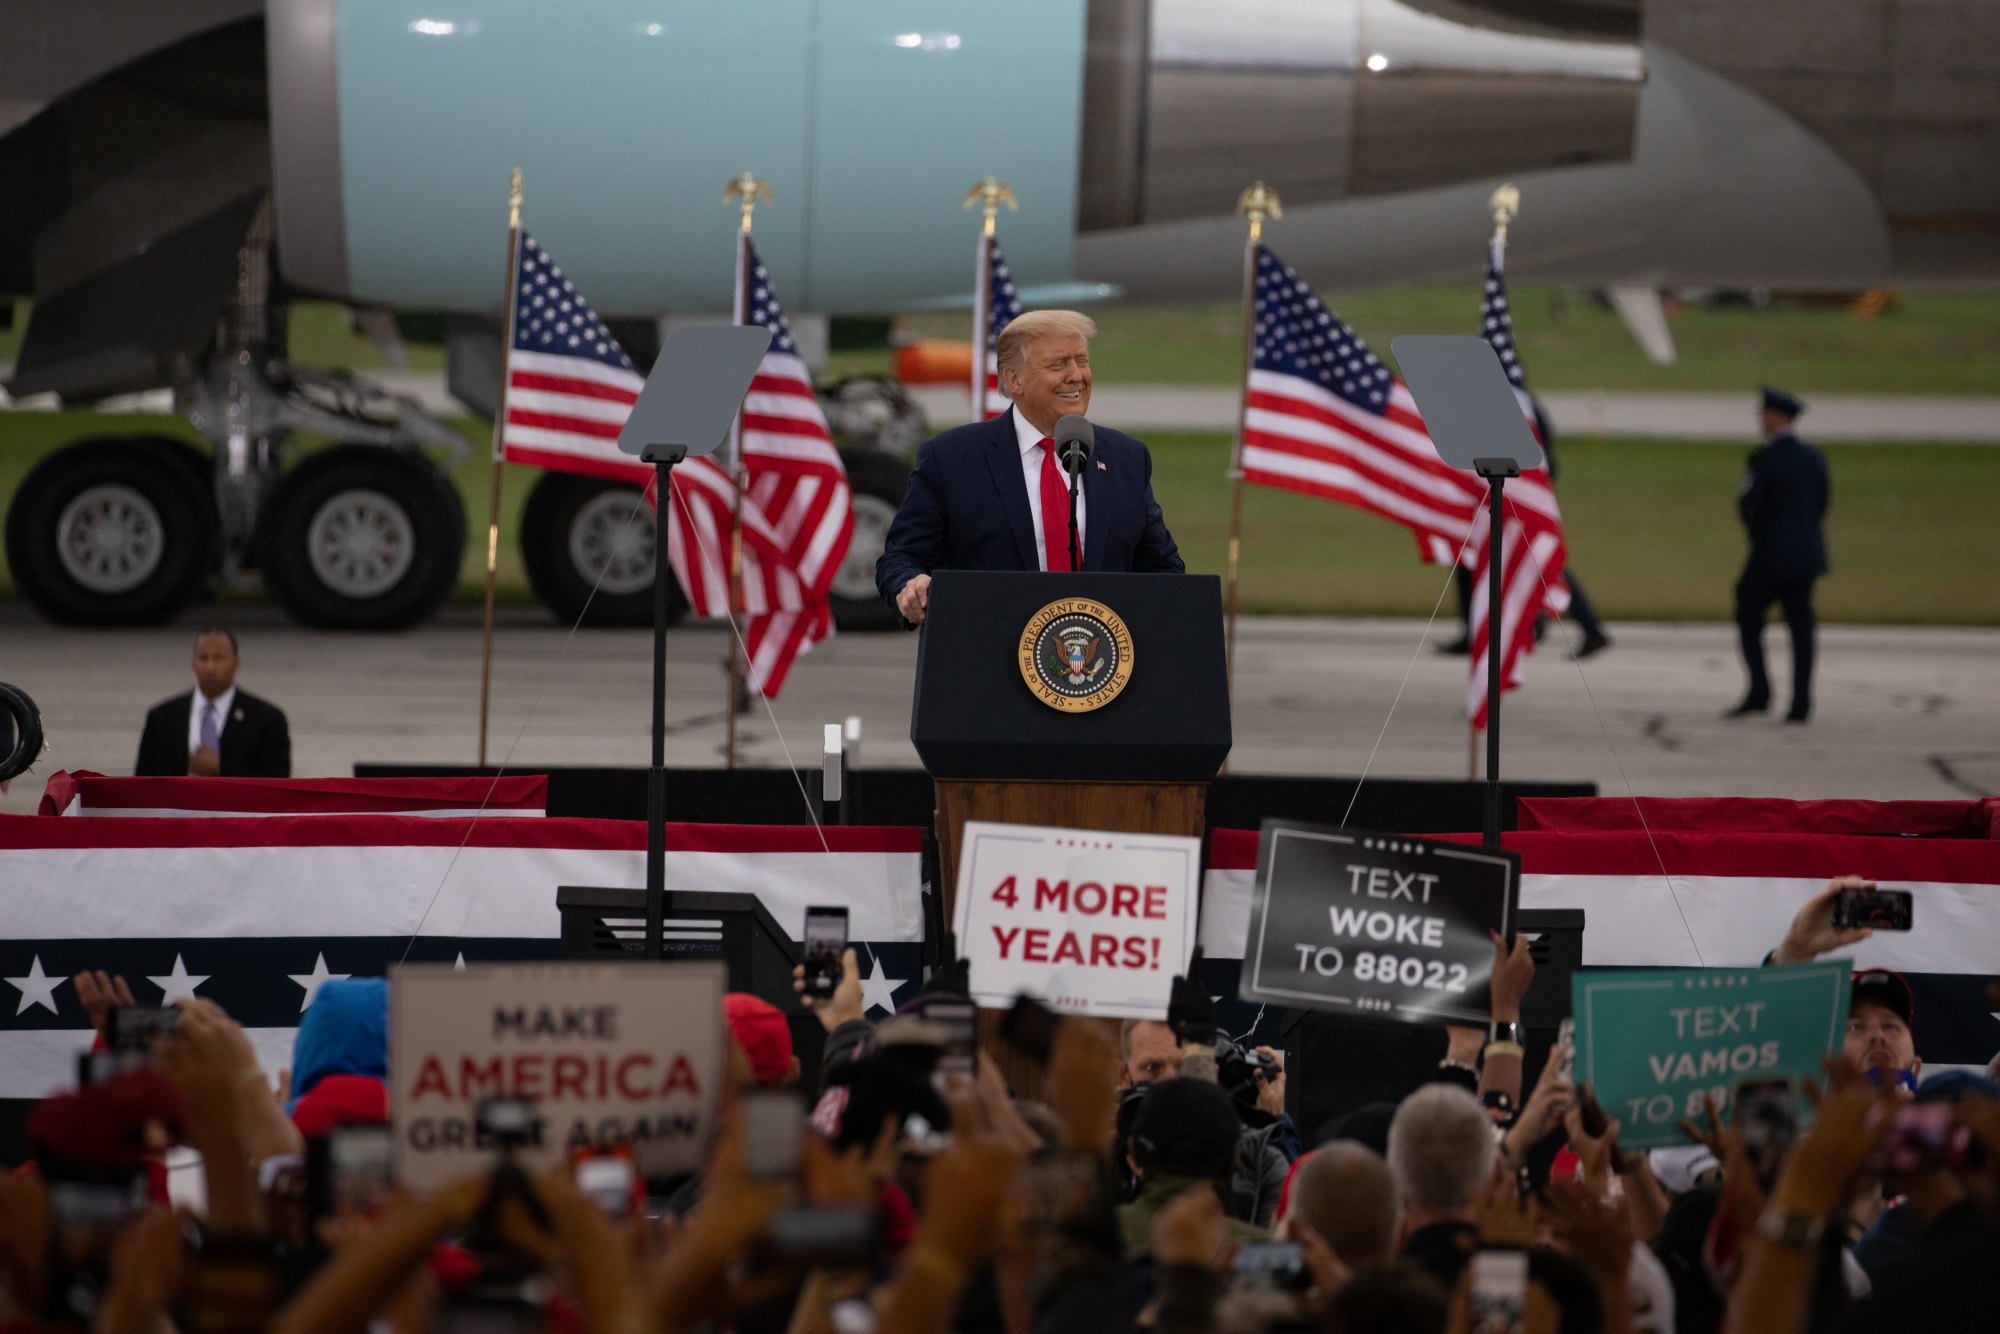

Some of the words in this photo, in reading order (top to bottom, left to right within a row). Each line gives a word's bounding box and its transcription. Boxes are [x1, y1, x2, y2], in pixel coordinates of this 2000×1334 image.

[1077, 603, 1088, 611] OF
[1090, 606, 1104, 617] THE
[1023, 602, 1074, 651] PRESIDENT
[1106, 616, 1130, 662] UNITED
[1024, 655, 1033, 671] THE
[1028, 673, 1037, 683] OF
[1036, 682, 1066, 706] SEAL
[1086, 672, 1125, 706] STATES
[991, 874, 1019, 909] 4
[1033, 877, 1168, 920] MORE
[1345, 864, 1439, 903] TEXT
[1329, 905, 1446, 947] WOKE
[991, 925, 1161, 970] YEARS!
[1295, 943, 1343, 977] TO
[1353, 952, 1468, 993] 88022
[493, 1004, 619, 1041] MAKE
[1670, 1002, 1766, 1039] TEXT
[409, 1052, 702, 1103] AMERICA
[1649, 1041, 1780, 1083] VAMOS
[1626, 1094, 1674, 1125] TO
[566, 1113, 699, 1148] AGAIN
